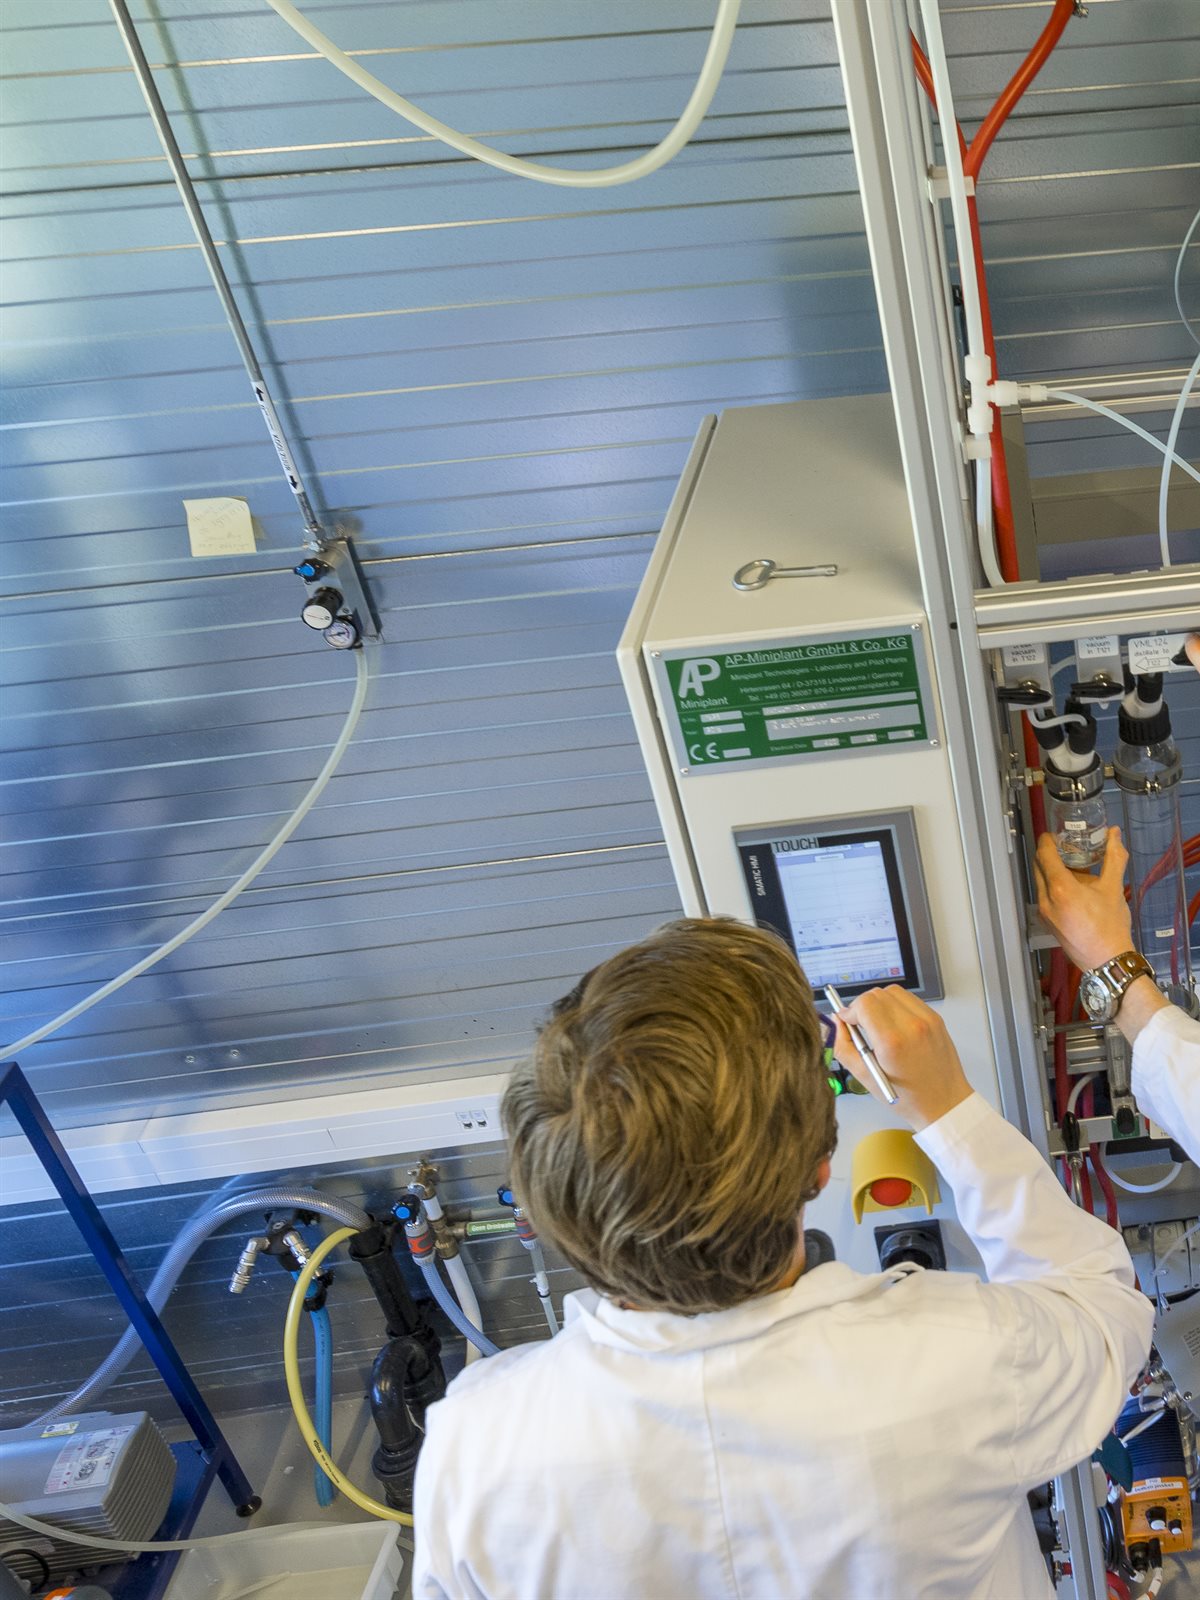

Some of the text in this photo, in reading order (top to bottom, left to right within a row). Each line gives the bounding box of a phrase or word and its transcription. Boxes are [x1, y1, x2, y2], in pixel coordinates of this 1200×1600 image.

[725, 636, 908, 667] AP-Miniplant GmbH & Co. KG
[678, 657, 721, 698] AP
[680, 696, 729, 711] Miniplant
[772, 837, 818, 854] TOUCH
